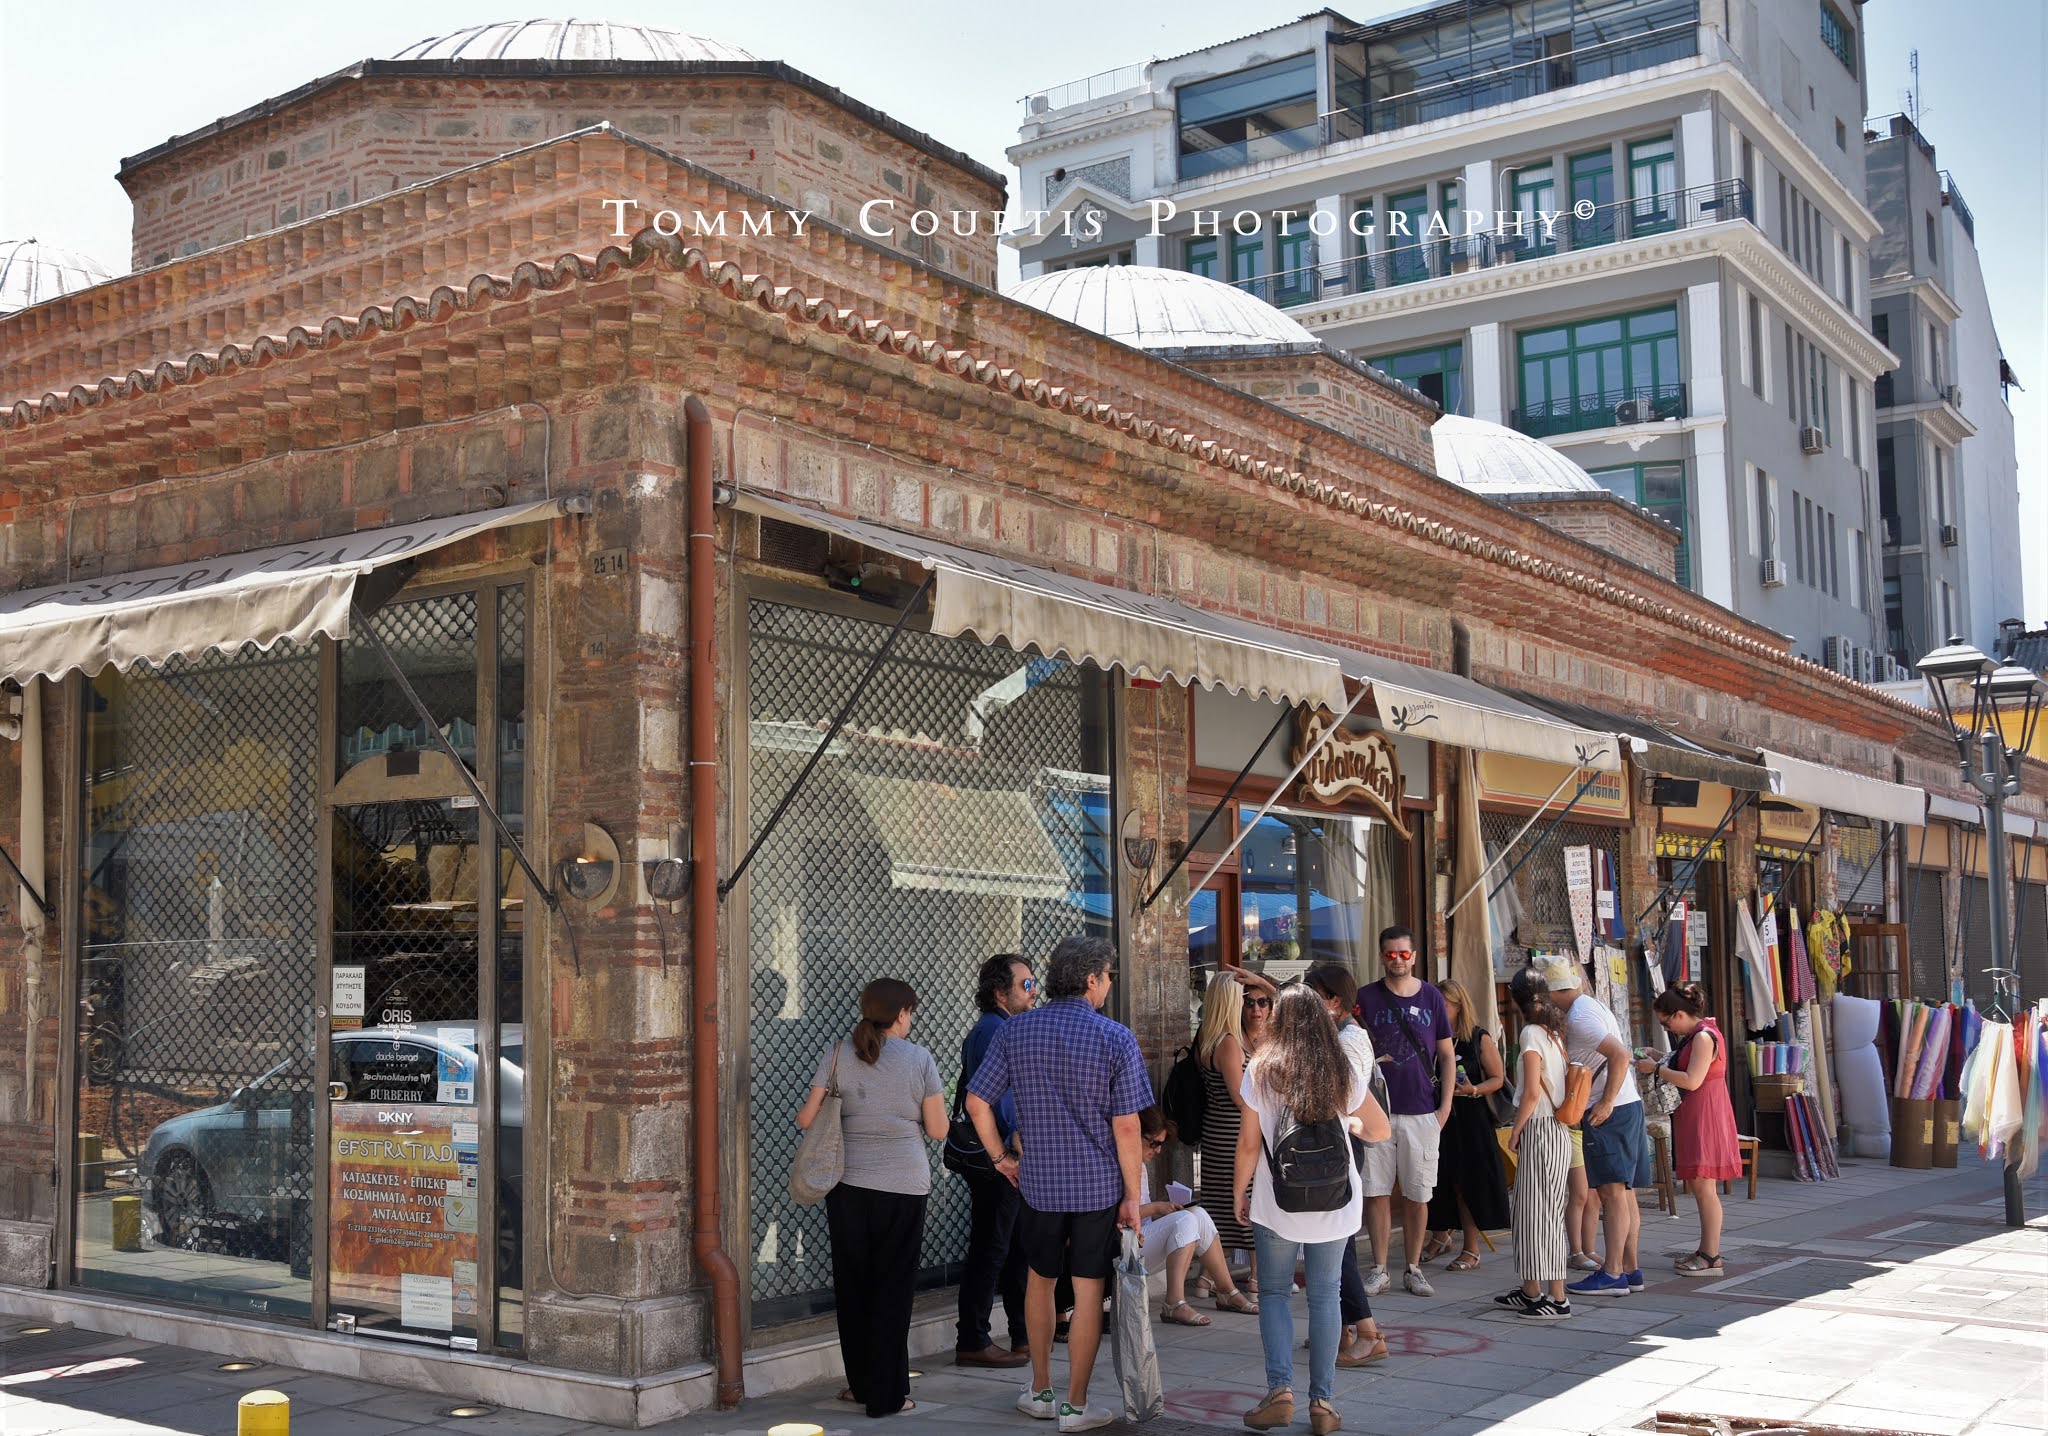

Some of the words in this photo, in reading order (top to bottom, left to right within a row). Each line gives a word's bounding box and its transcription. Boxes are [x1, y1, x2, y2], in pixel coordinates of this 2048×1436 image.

[382, 1009, 412, 1023] ORIS
[370, 1088, 424, 1102] BURBERRY
[378, 1111, 414, 1124] DKNY
[342, 1171, 400, 1186] ΚΑΤΑΣΚΕΥΕΣ
[343, 1188, 406, 1204] ΚΟΣΜΗΜΑΤΑ
[371, 1208, 432, 1224] ΑΝΤΑΛΛΑΓΕΣ
